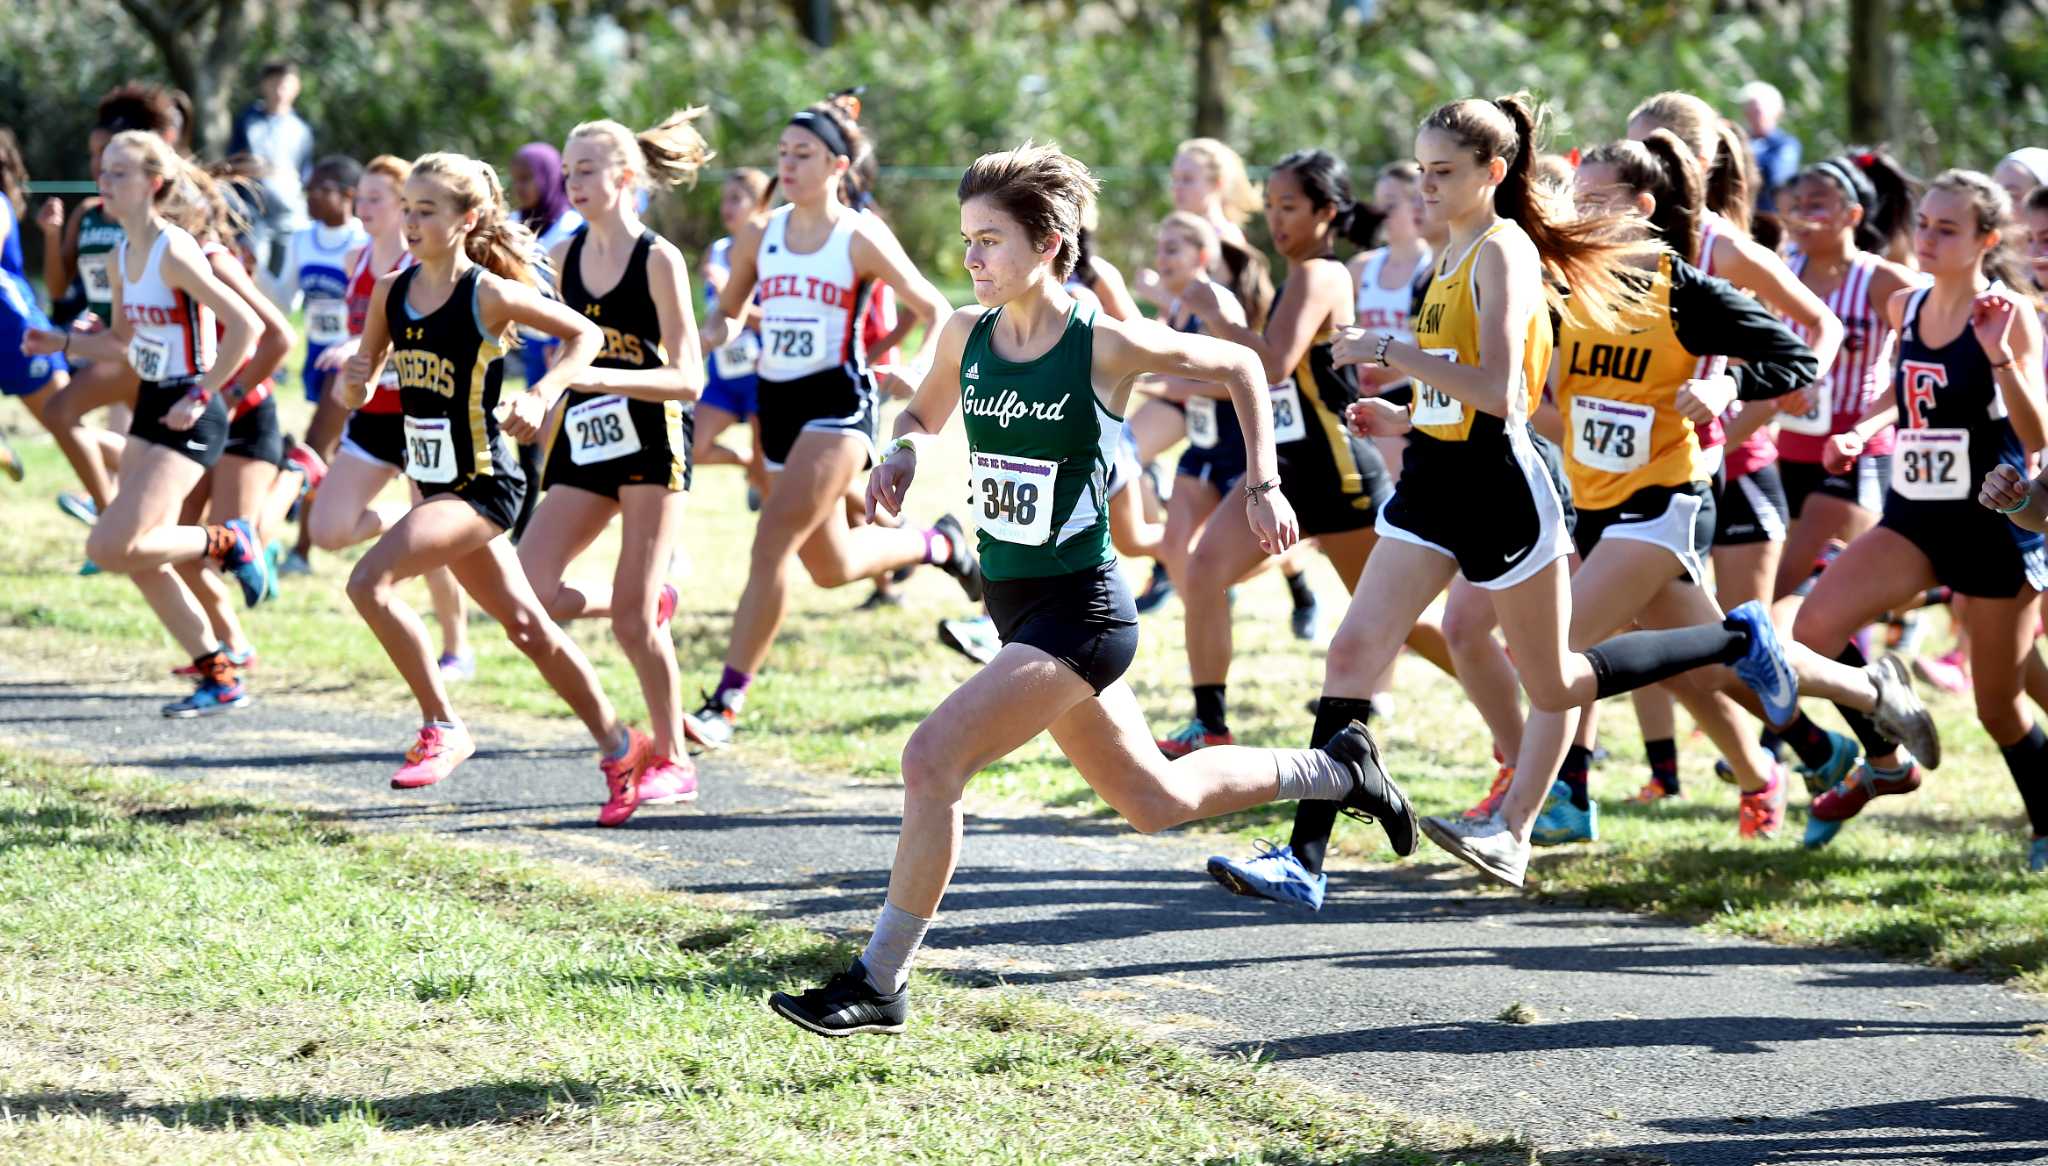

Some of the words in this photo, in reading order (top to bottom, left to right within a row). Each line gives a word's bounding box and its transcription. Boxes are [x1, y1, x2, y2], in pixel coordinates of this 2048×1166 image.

[770, 329, 814, 357] 723
[1569, 342, 1652, 384] LAW
[963, 384, 1071, 428] Guilford
[1901, 360, 1949, 430] F
[577, 412, 624, 450] 203
[1583, 418, 1635, 458] 473
[1001, 459, 1051, 476] Championship
[1904, 451, 1958, 483] 312
[982, 478, 1039, 526] 348
